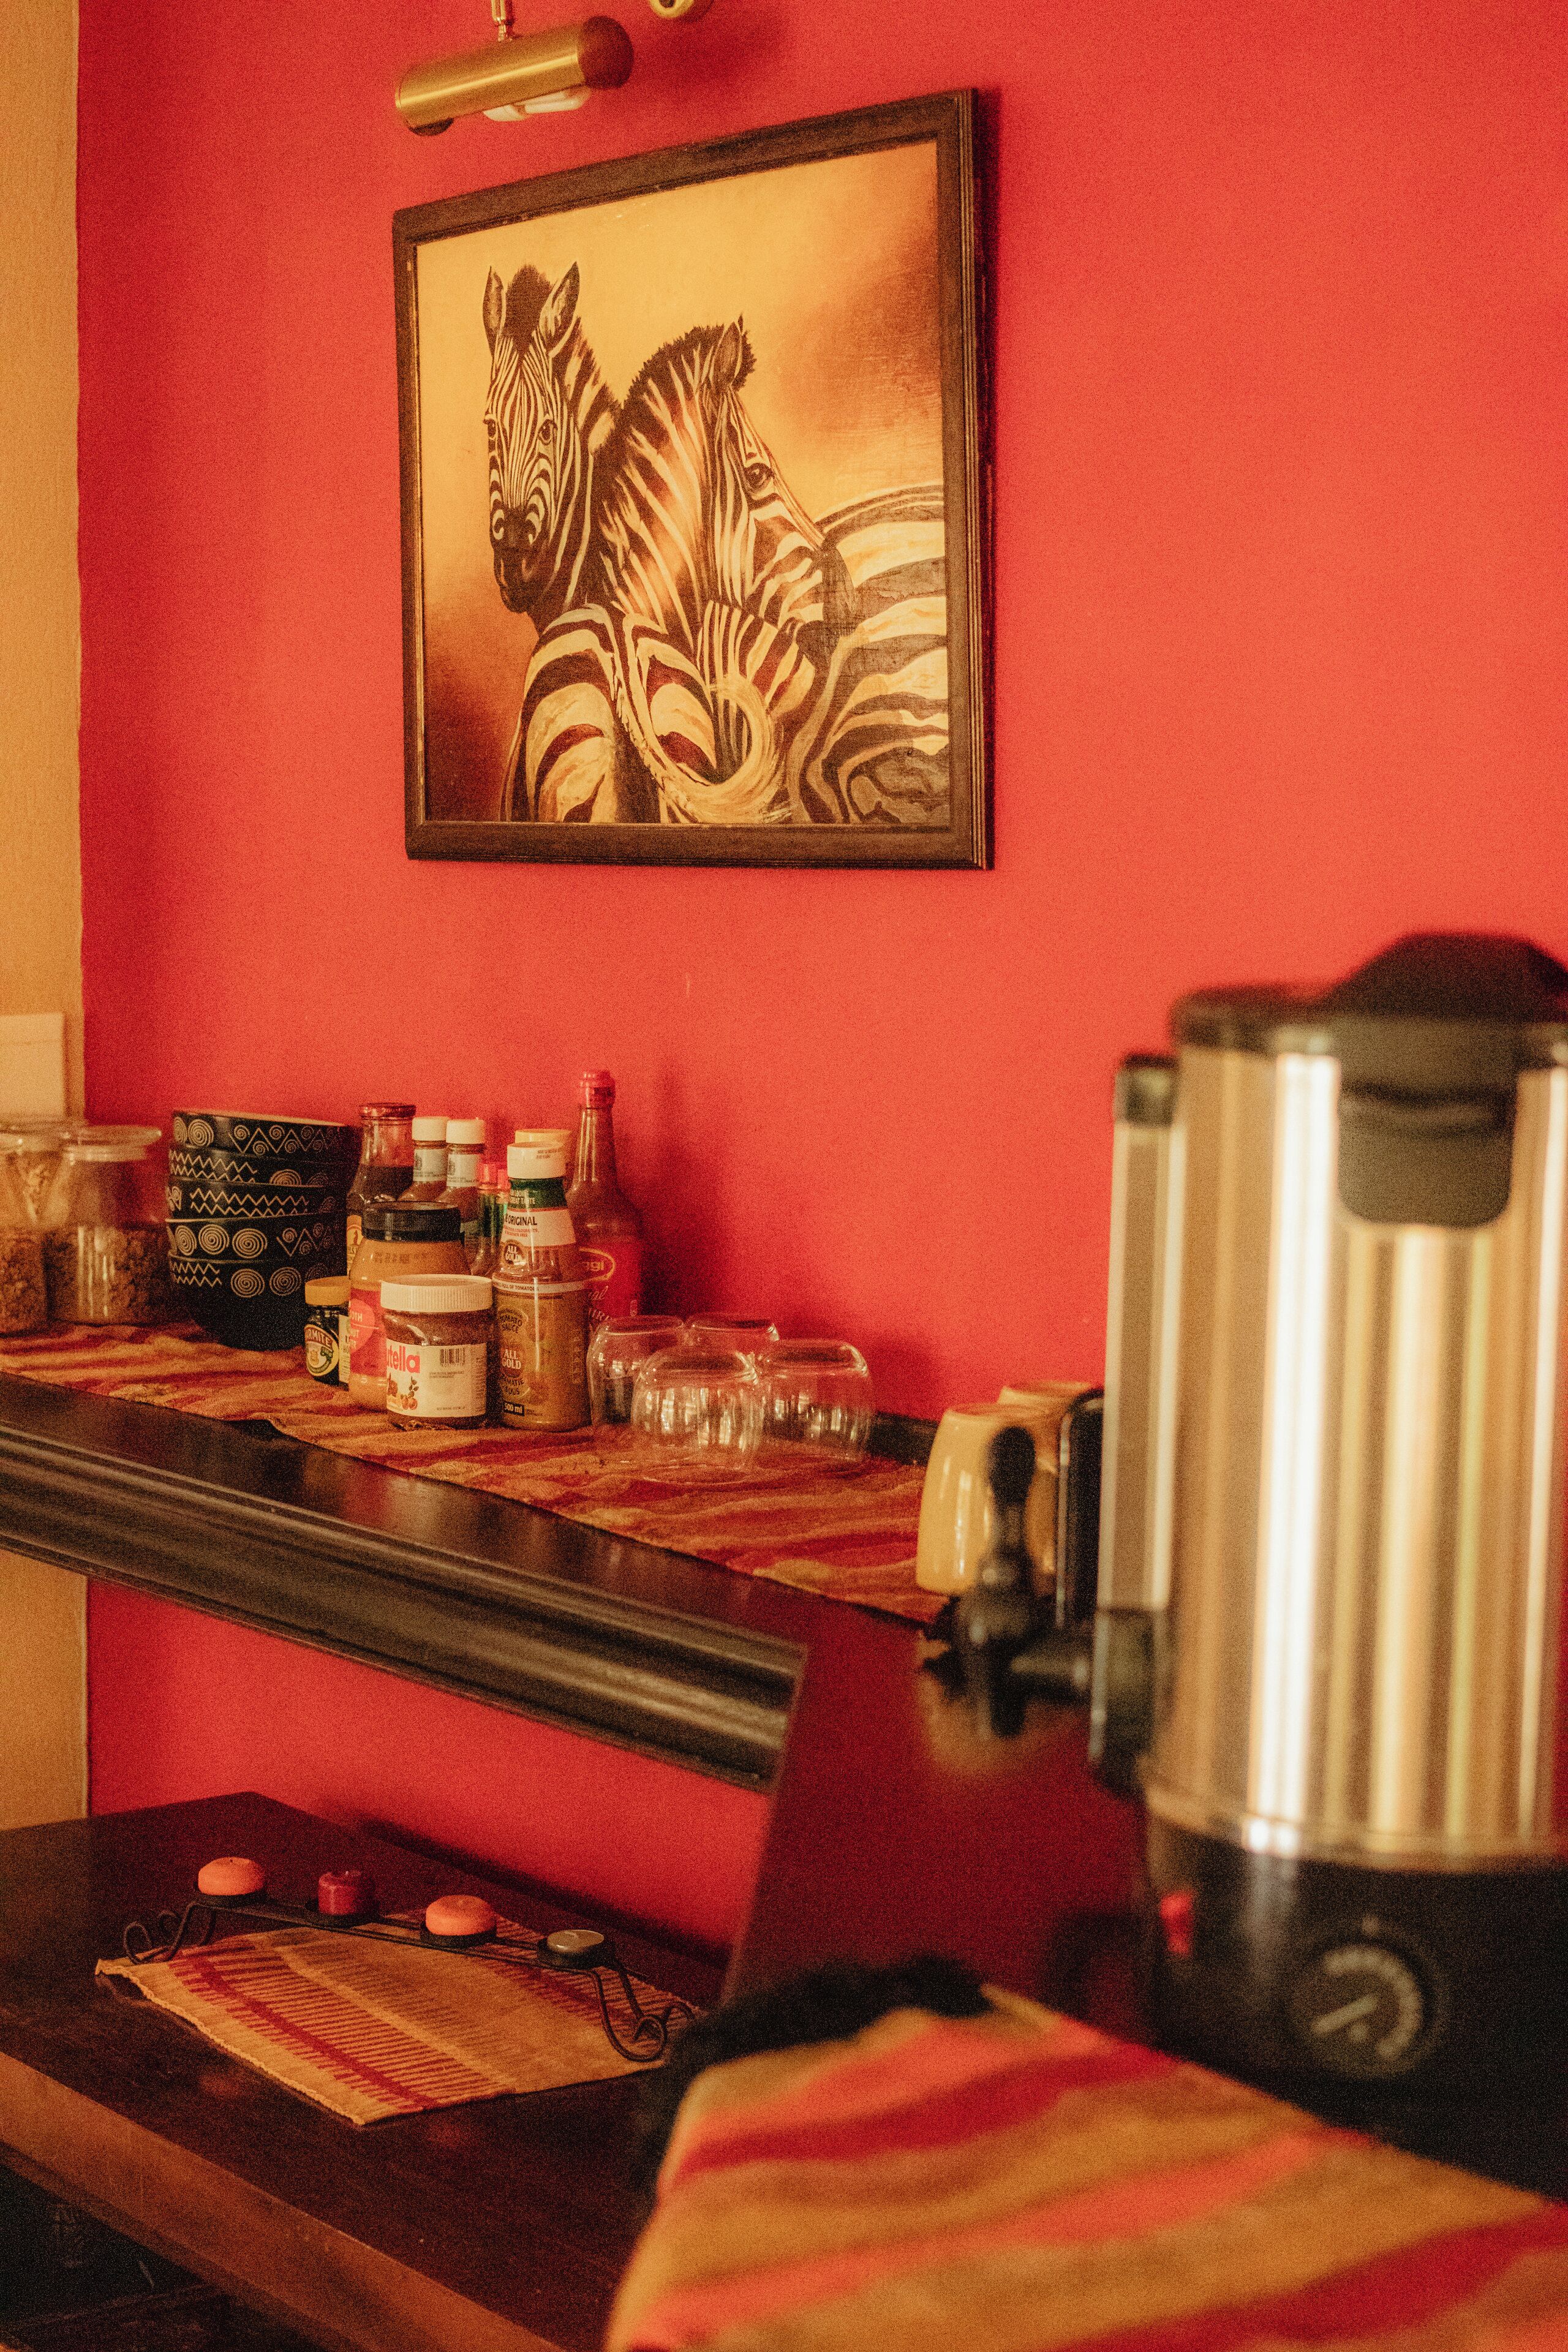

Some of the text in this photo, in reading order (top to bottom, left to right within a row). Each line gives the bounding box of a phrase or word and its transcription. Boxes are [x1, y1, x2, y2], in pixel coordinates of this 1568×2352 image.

[508, 1215, 537, 1226] ORIGINAL
[507, 1245, 518, 1254] ALL
[505, 1252, 521, 1262] GOLD
[502, 1323, 519, 1333] SAUCE
[503, 1348, 519, 1360] ALL
[501, 1357, 522, 1370] GOLD
